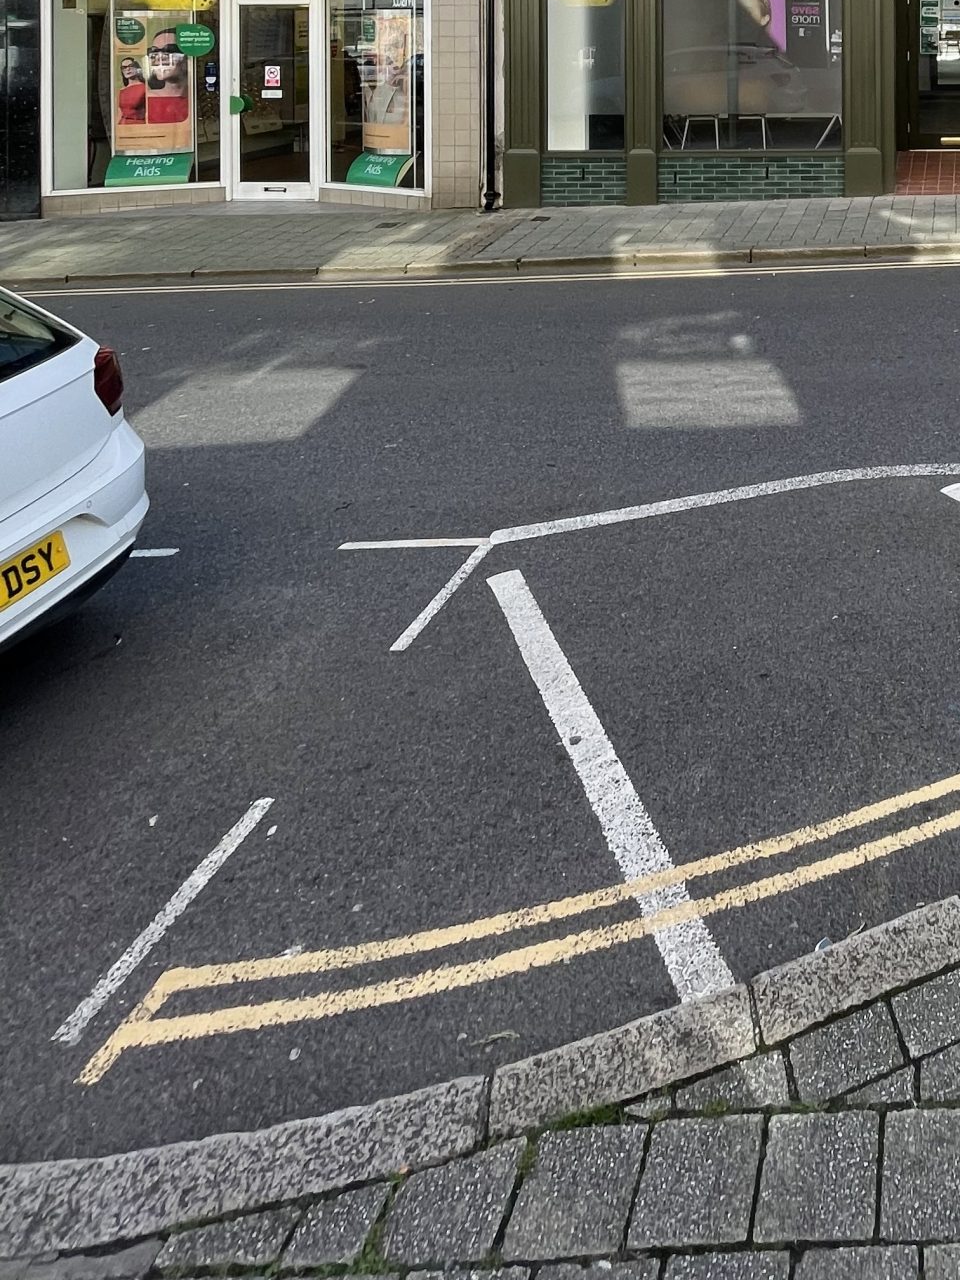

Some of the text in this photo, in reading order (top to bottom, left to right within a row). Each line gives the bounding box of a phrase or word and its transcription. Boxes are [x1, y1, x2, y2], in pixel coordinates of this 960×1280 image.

[125, 156, 175, 166] Hearing
[133, 166, 161, 177] Aids
[364, 164, 383, 175] Aids
[1, 541, 54, 599] DSY
